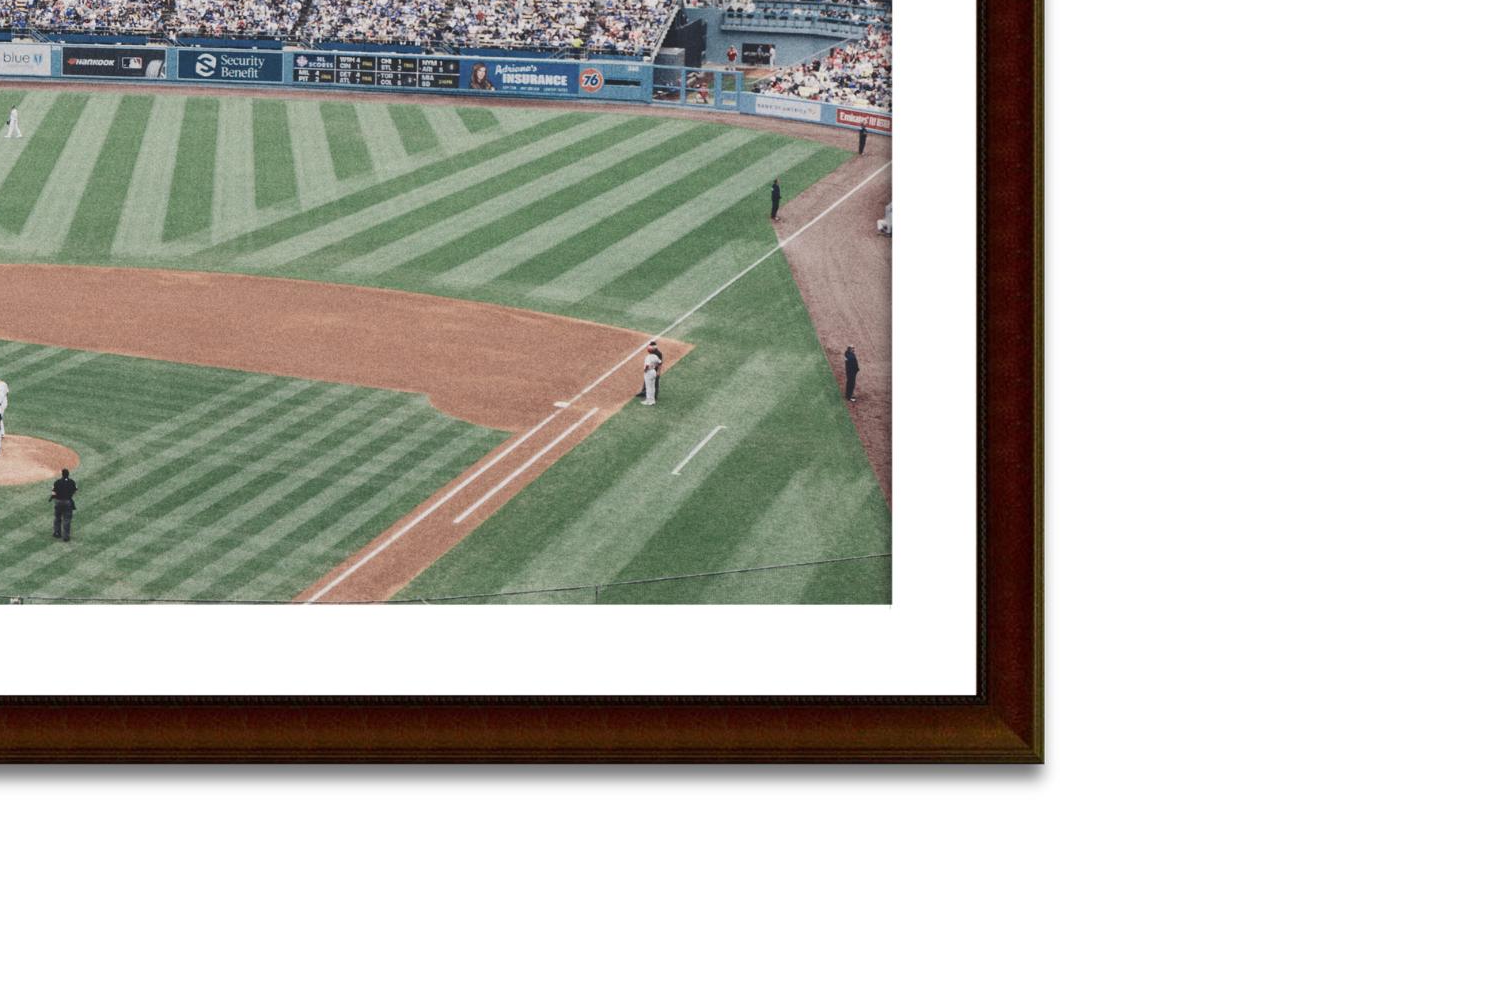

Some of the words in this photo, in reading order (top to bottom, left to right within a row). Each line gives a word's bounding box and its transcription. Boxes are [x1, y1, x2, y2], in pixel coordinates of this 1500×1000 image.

[3, 52, 30, 63] blue
[221, 54, 266, 68] Security
[221, 67, 259, 79] Benefit
[495, 64, 538, 76] Adriana's
[502, 73, 568, 86] INSURANCE
[583, 74, 599, 86] 76
